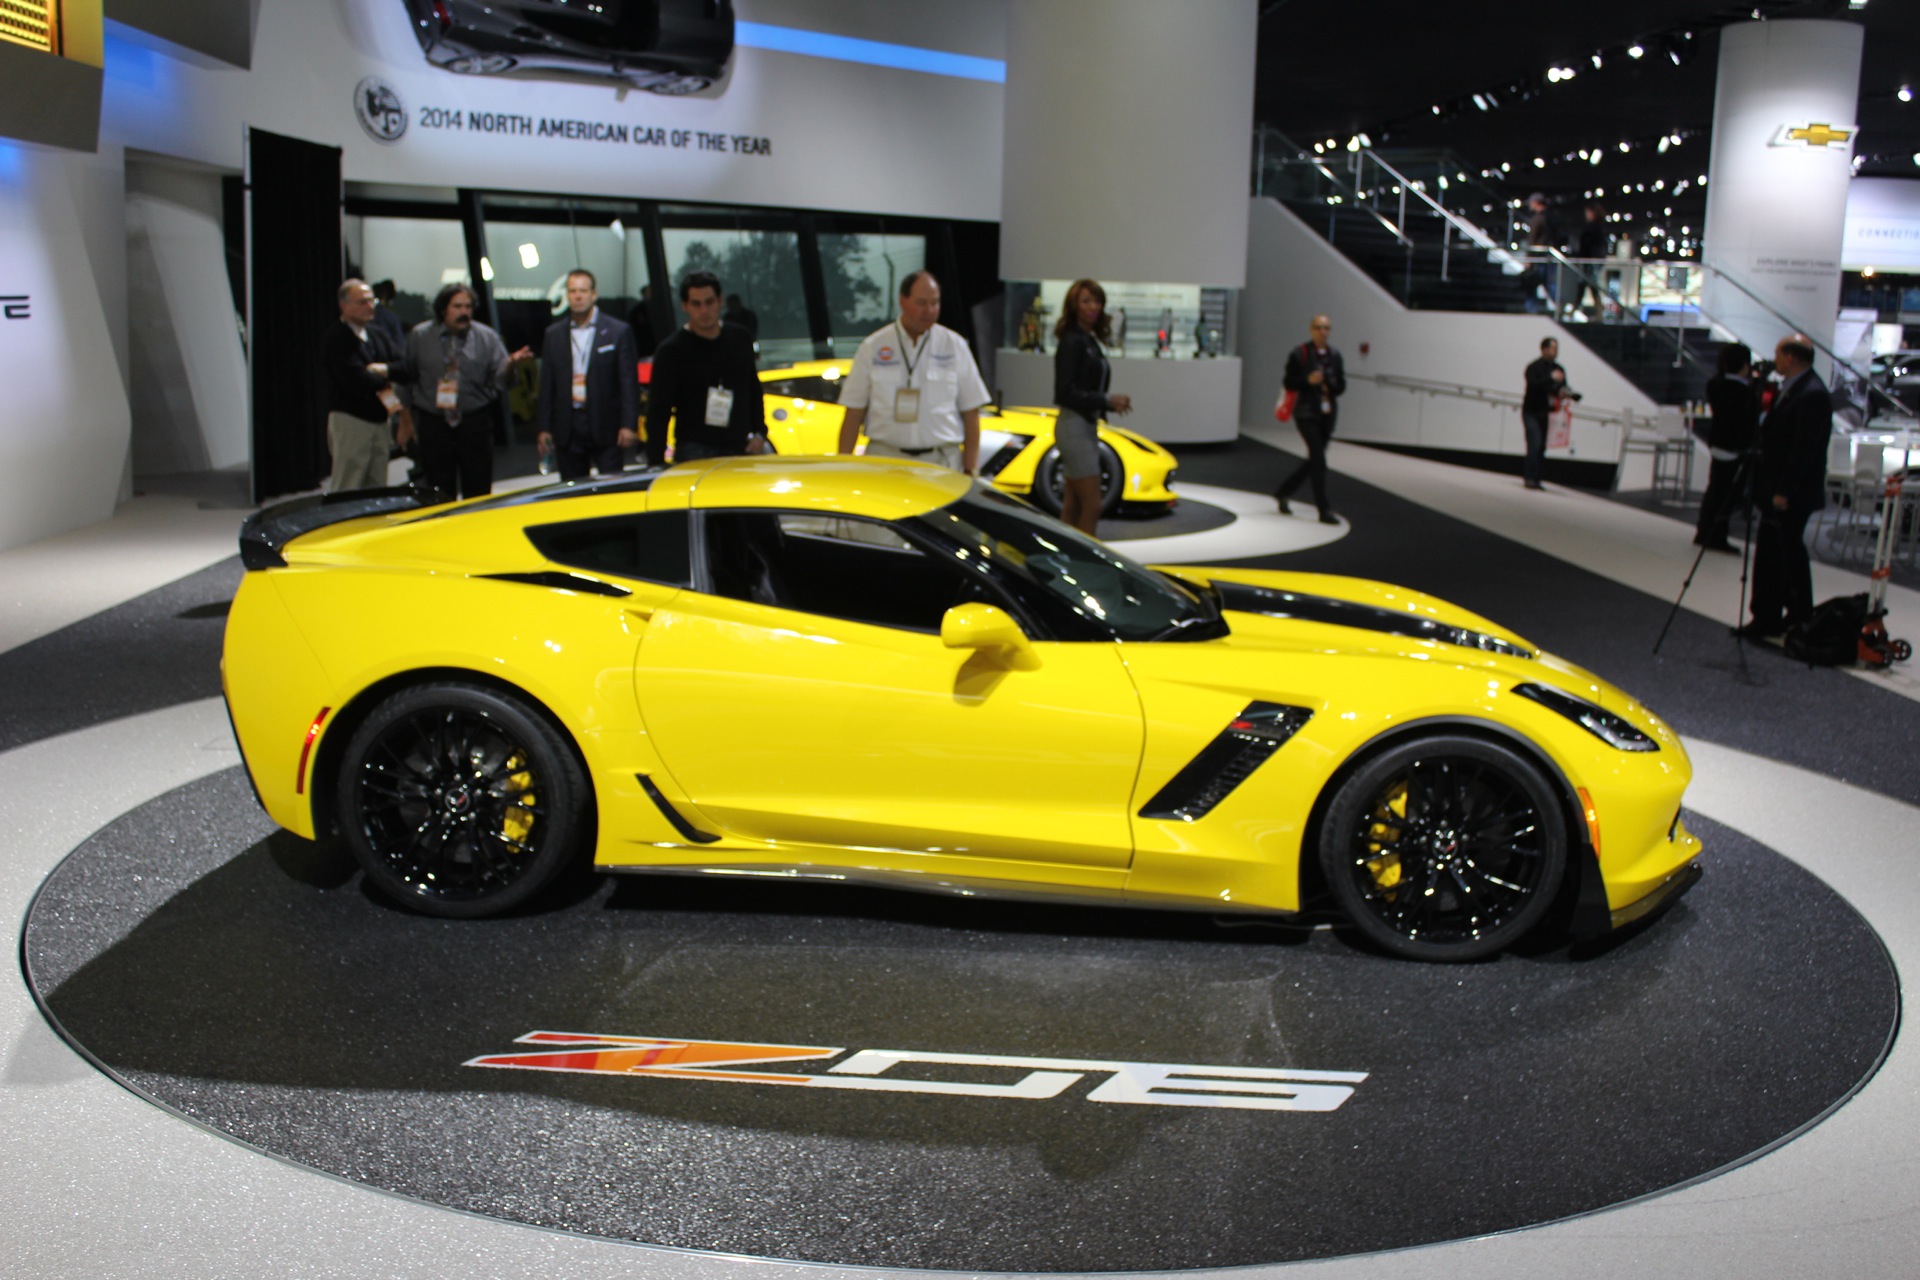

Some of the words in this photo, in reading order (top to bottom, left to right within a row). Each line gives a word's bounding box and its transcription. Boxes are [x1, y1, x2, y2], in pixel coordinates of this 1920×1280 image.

[419, 106, 463, 129] 2014
[469, 111, 532, 136] NORTH
[537, 118, 628, 143] AMERICAN
[633, 124, 666, 147] CAR
[671, 128, 691, 148] OF
[696, 131, 727, 152] THE
[731, 135, 772, 156] YEAR
